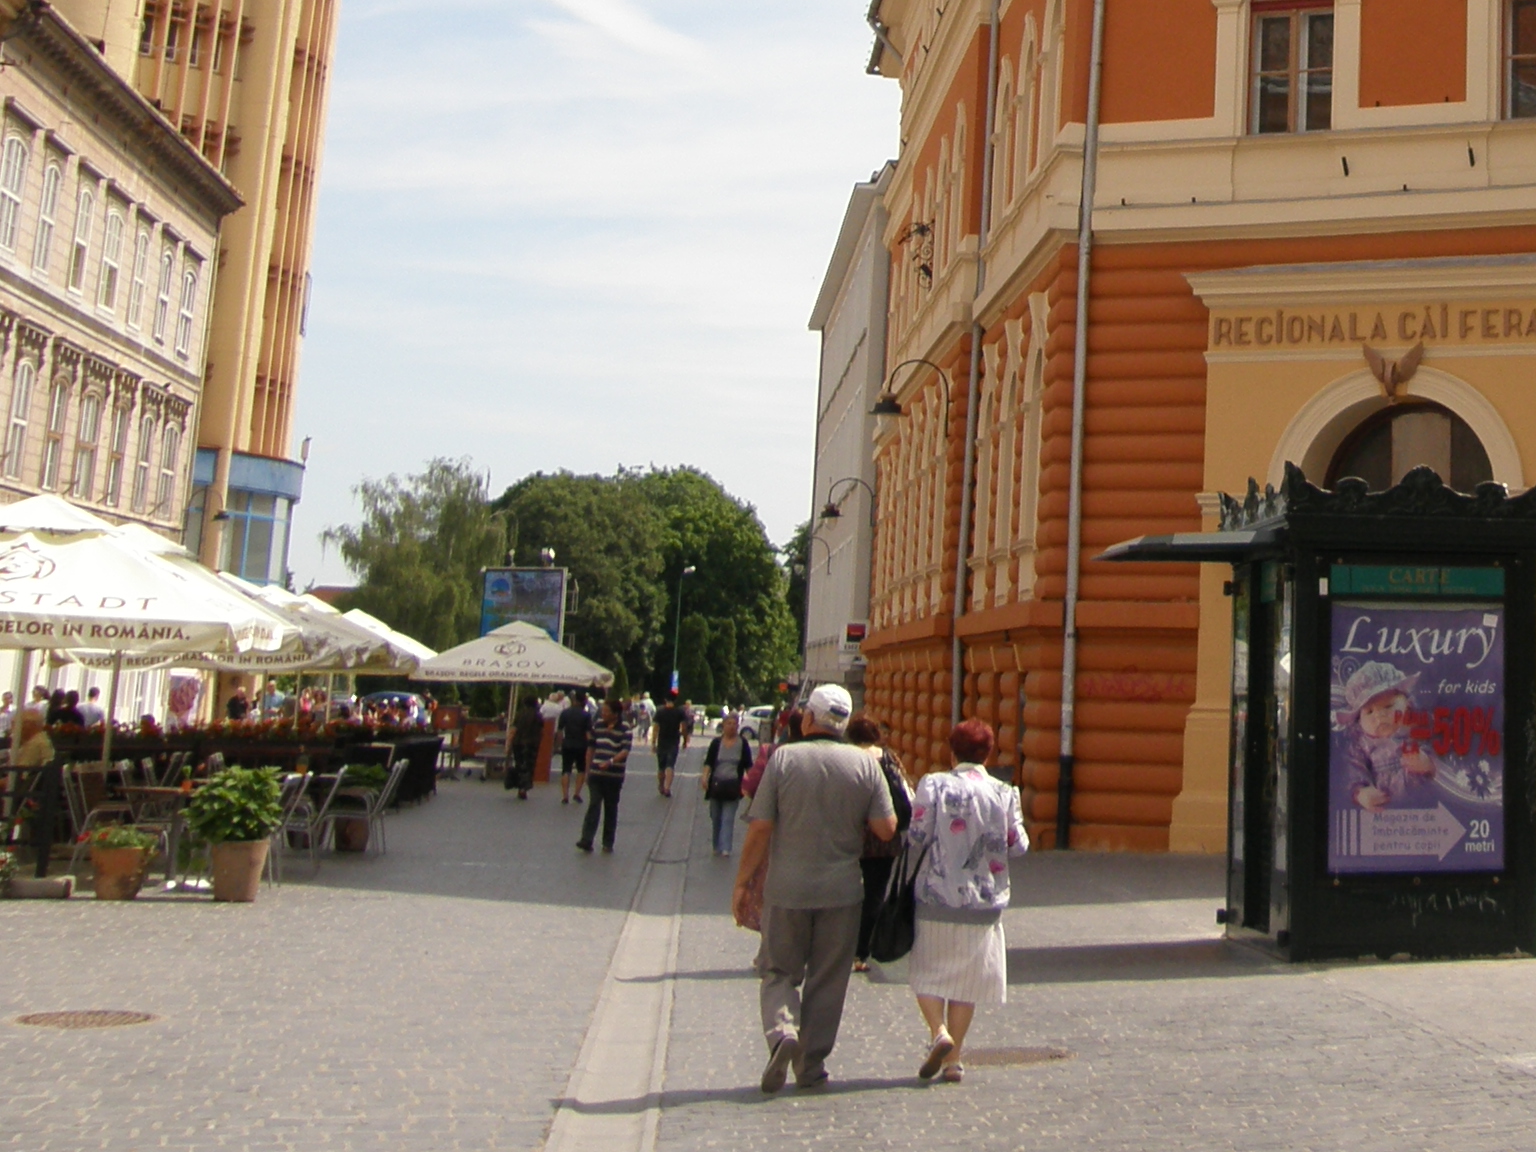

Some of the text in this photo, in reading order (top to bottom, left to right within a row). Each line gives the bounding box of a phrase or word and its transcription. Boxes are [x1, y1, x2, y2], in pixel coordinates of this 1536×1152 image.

[1388, 567, 1452, 585] CARTE
[1340, 615, 1497, 668] Luxury
[1437, 679, 1461, 695] for
[1465, 679, 1496, 695] kids
[1410, 706, 1501, 757] -50%
[1373, 813, 1436, 825] Magazin de
[1469, 819, 1490, 839] 20
[1373, 840, 1440, 852] pentru copii
[1465, 840, 1496, 853] metri
